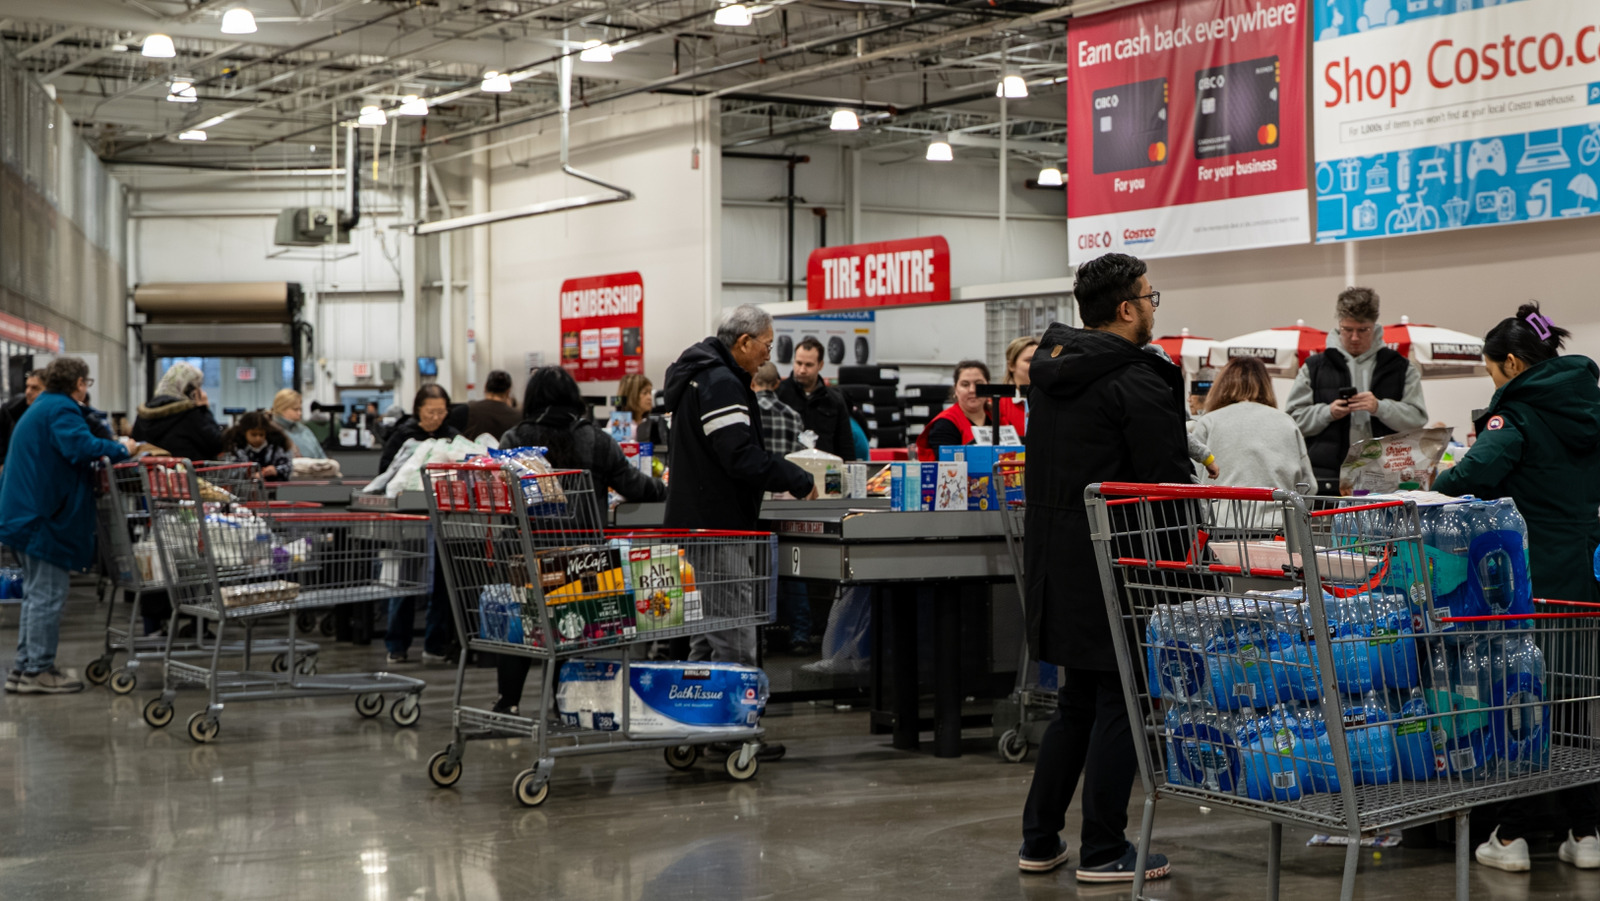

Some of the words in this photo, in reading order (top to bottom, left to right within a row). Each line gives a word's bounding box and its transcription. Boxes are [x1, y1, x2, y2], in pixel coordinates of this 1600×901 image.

[1078, 41, 1112, 67] Earn
[1114, 28, 1151, 60] cash
[1154, 19, 1192, 51] back
[1195, 2, 1297, 43] everywhere
[1324, 56, 1411, 108] Shop
[1427, 25, 1600, 89] Costco.c
[1487, 103, 1505, 115] local
[1507, 99, 1532, 113] Costco
[1198, 166, 1213, 181] For
[1214, 164, 1235, 182] your
[1236, 158, 1277, 176] business
[1114, 178, 1128, 193] For
[1129, 178, 1145, 193] you
[1078, 233, 1102, 250] CIBC
[822, 257, 861, 300] TIRE
[865, 249, 935, 297] CENTRE
[561, 285, 643, 319] MEMBERSHIP
[1229, 348, 1275, 358] KIRKLAND
[650, 564, 670, 577] All-
[793, 548, 799, 573] 9
[639, 575, 675, 588] Bran
